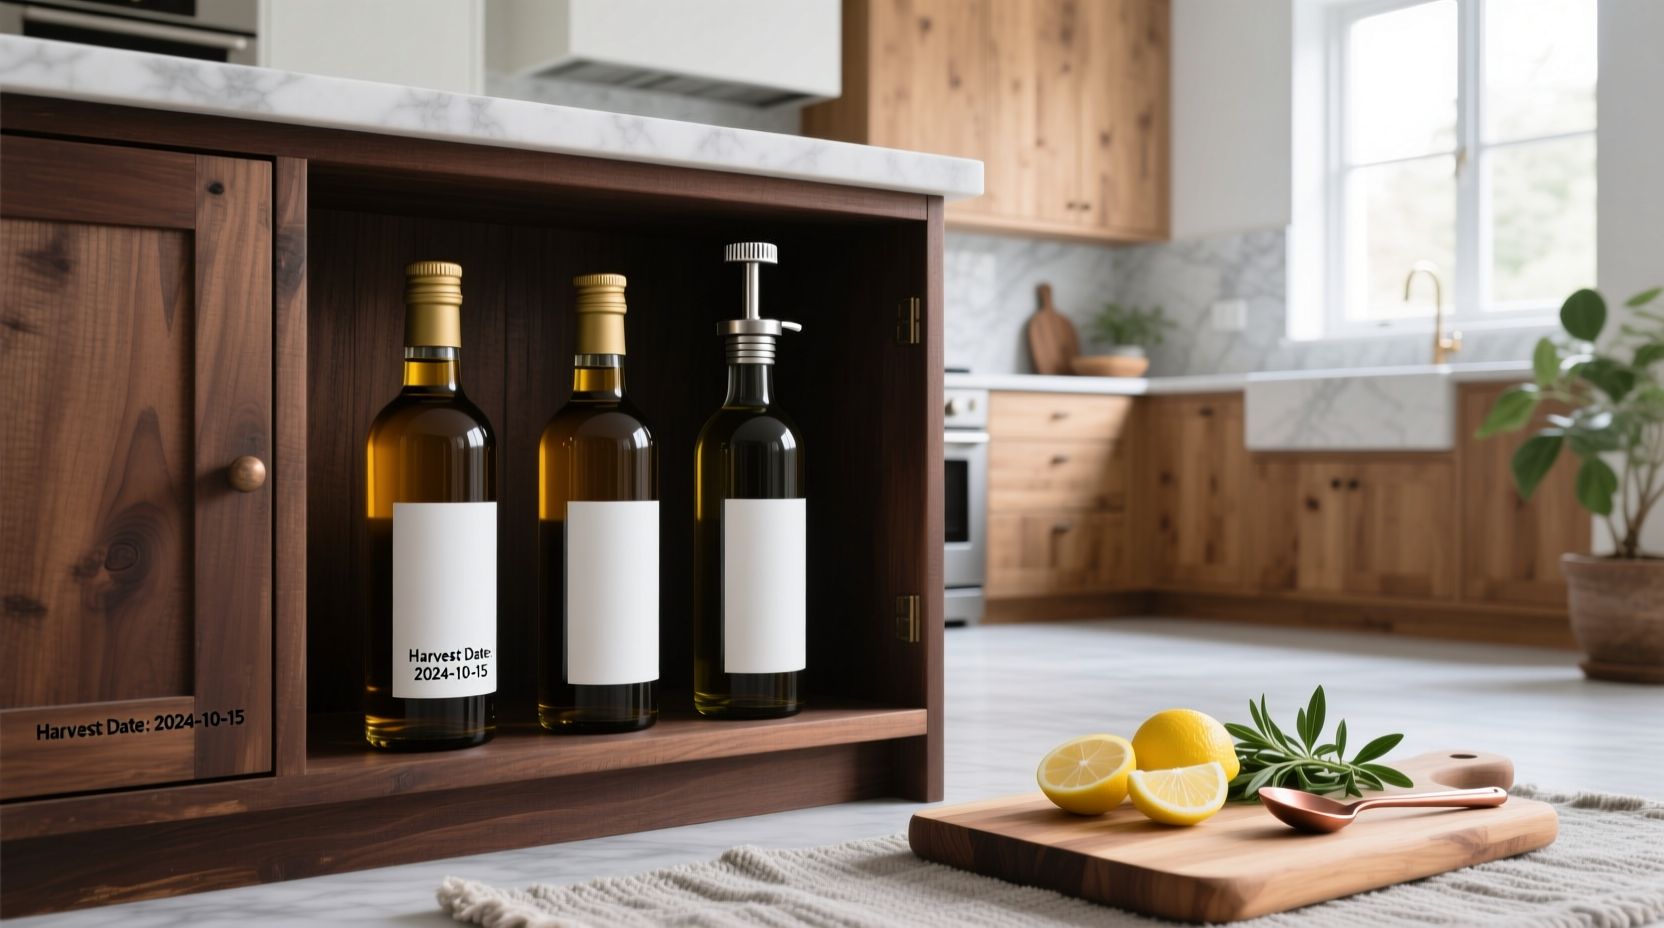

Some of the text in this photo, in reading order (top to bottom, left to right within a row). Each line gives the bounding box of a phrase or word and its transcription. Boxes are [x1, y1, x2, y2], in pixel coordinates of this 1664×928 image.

[409, 648, 462, 663] Harvest
[414, 664, 488, 681] 2024-10-15
[36, 709, 245, 740] Harvest Date: 2024-10-15
